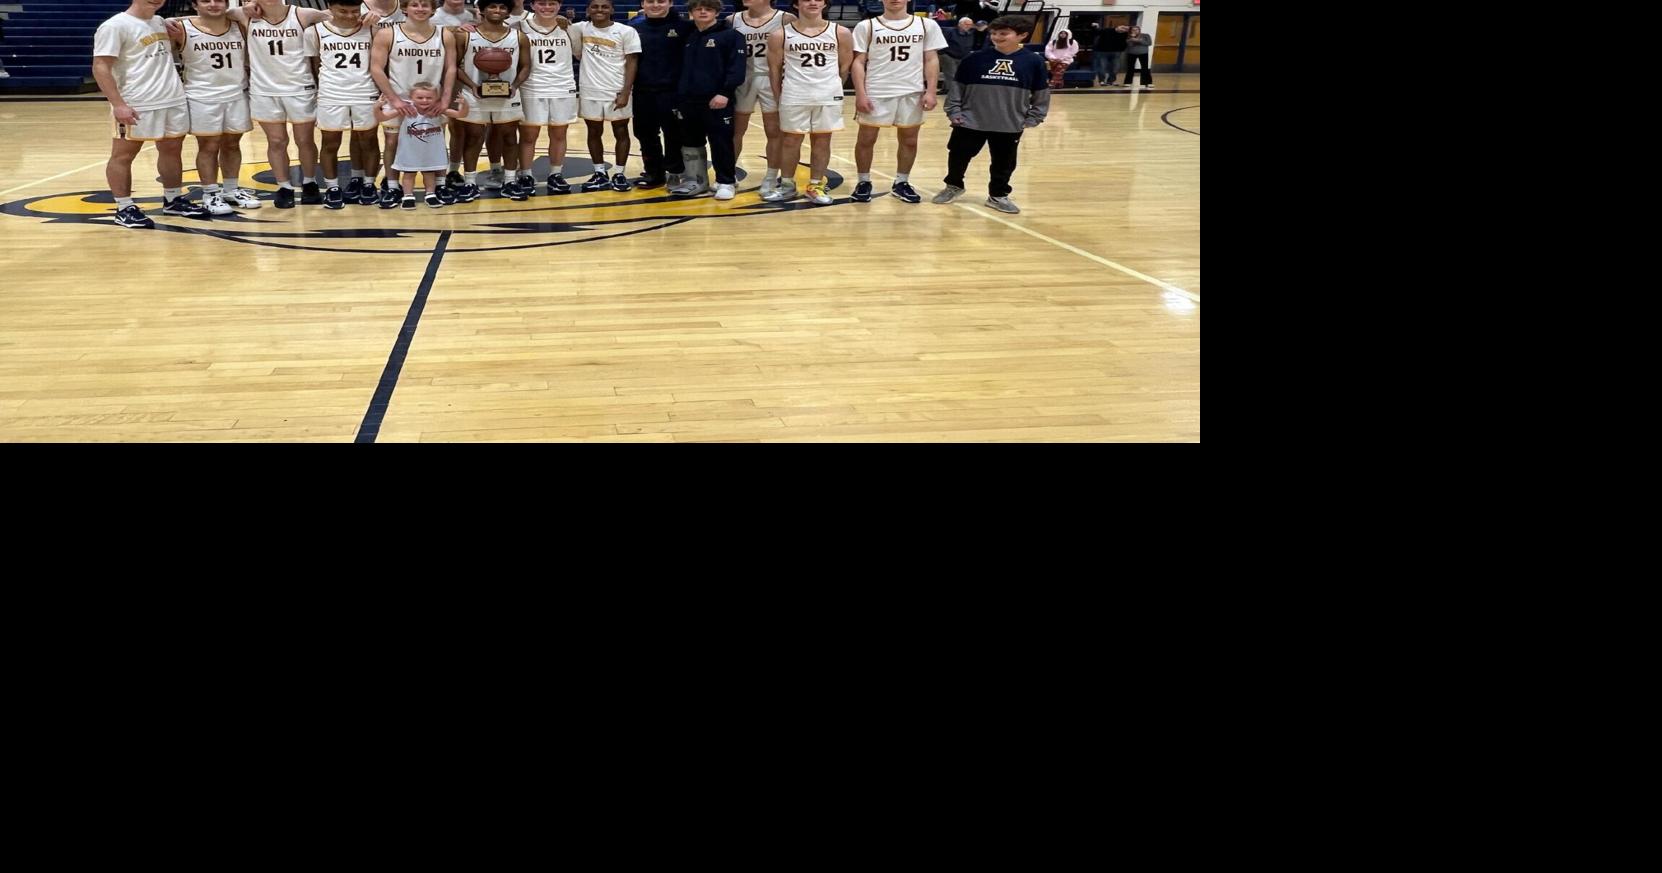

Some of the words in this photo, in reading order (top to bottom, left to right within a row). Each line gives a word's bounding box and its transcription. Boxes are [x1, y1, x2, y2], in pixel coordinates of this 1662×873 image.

[252, 28, 298, 39] ANDOVER
[876, 35, 924, 45] ANDOVER
[193, 41, 243, 51] ANDOVER
[268, 40, 284, 56] 11
[323, 42, 370, 51] ANDOVER
[531, 38, 566, 47] NDOVER
[789, 43, 836, 52] ANDOVER
[397, 48, 441, 57] ANDOVER
[538, 49, 556, 64] 12
[890, 46, 911, 61] 15
[211, 53, 232, 69] 31
[334, 53, 361, 69] 24
[416, 60, 423, 75] 1
[800, 53, 827, 68] 20
[989, 59, 1015, 76] A
